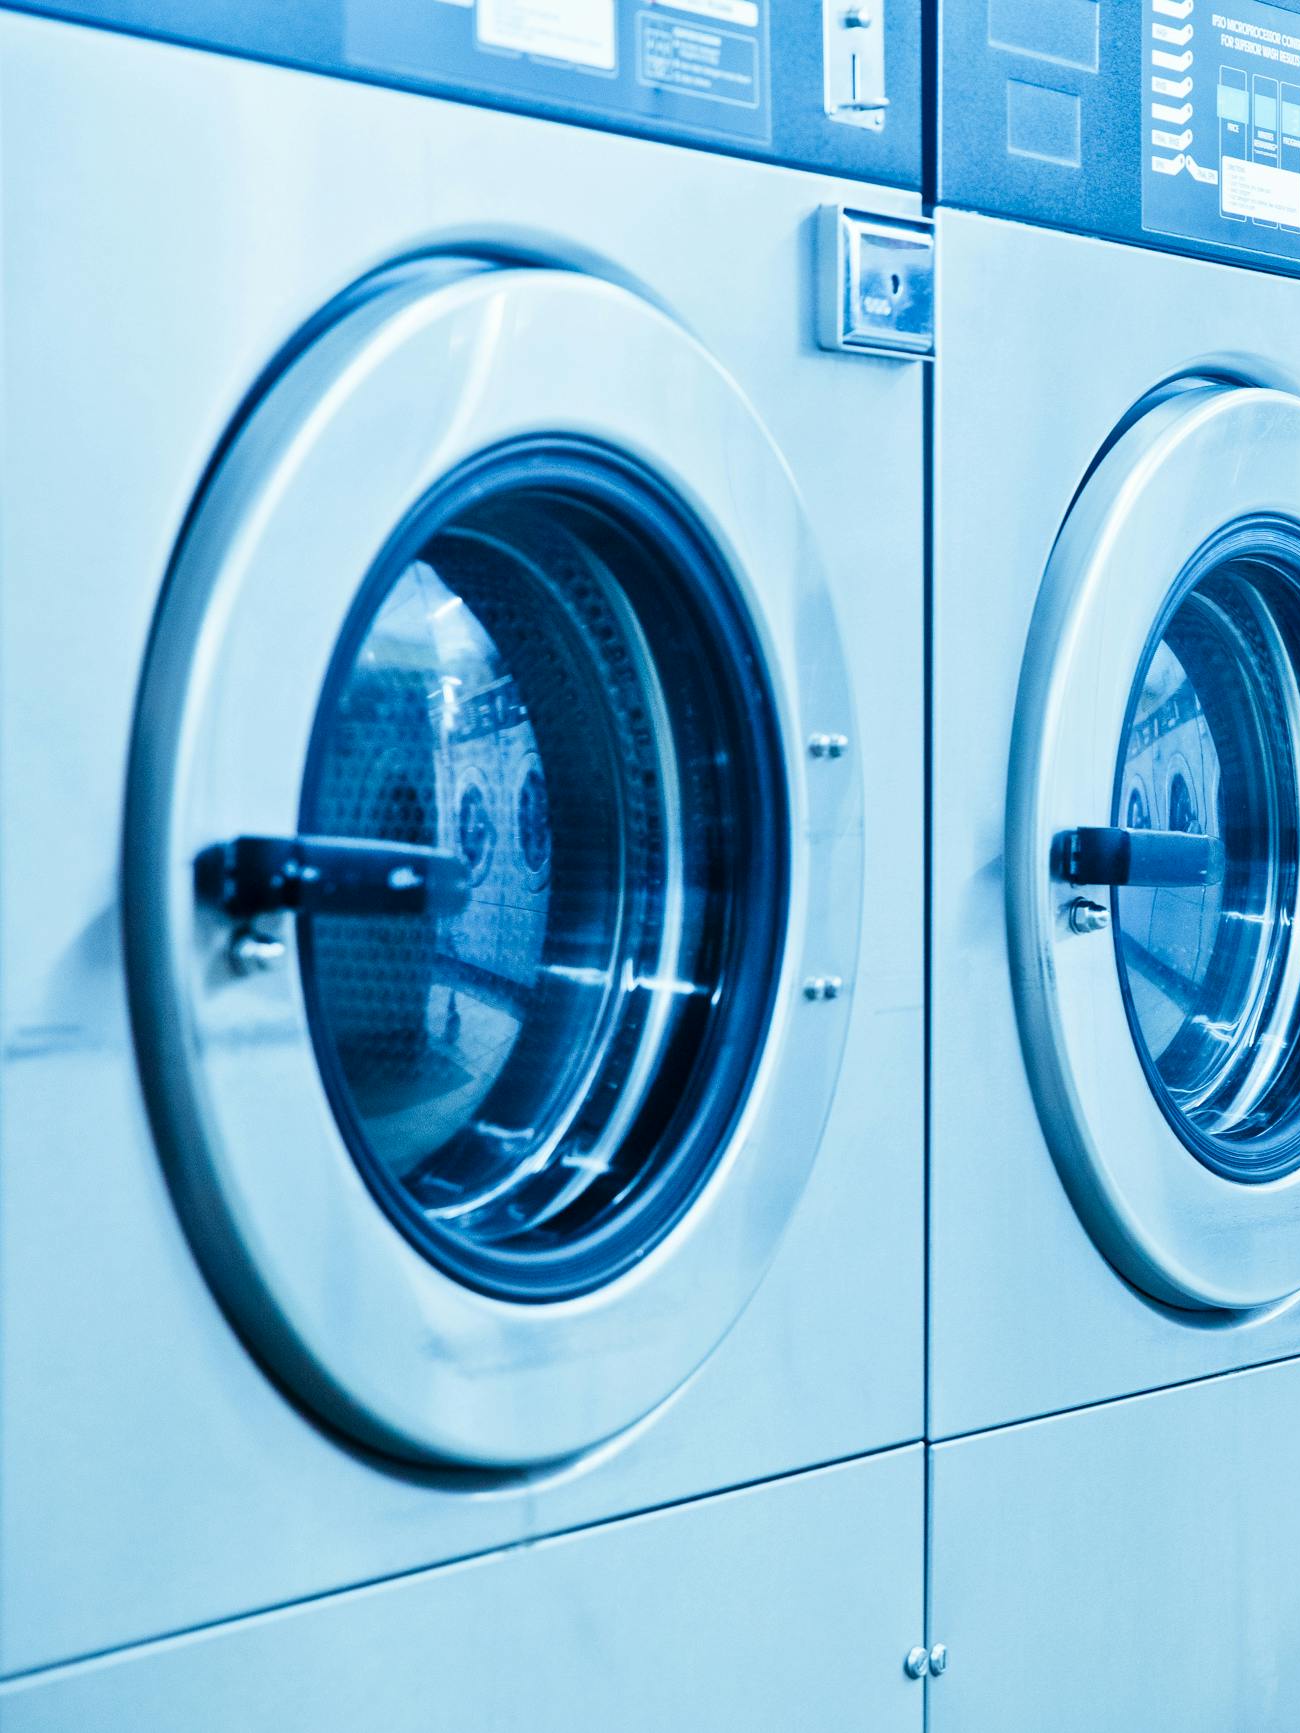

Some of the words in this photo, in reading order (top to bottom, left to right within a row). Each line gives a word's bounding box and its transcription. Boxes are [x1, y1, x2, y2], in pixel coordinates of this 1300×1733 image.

[1212, 14, 1226, 29] IPSO
[1227, 18, 1281, 45] MICROPROCESSOR
[1221, 33, 1234, 48] FOR
[1234, 37, 1262, 56] SUPERIOR
[1262, 45, 1279, 60] WASH
[1279, 50, 1300, 67] RESULTS
